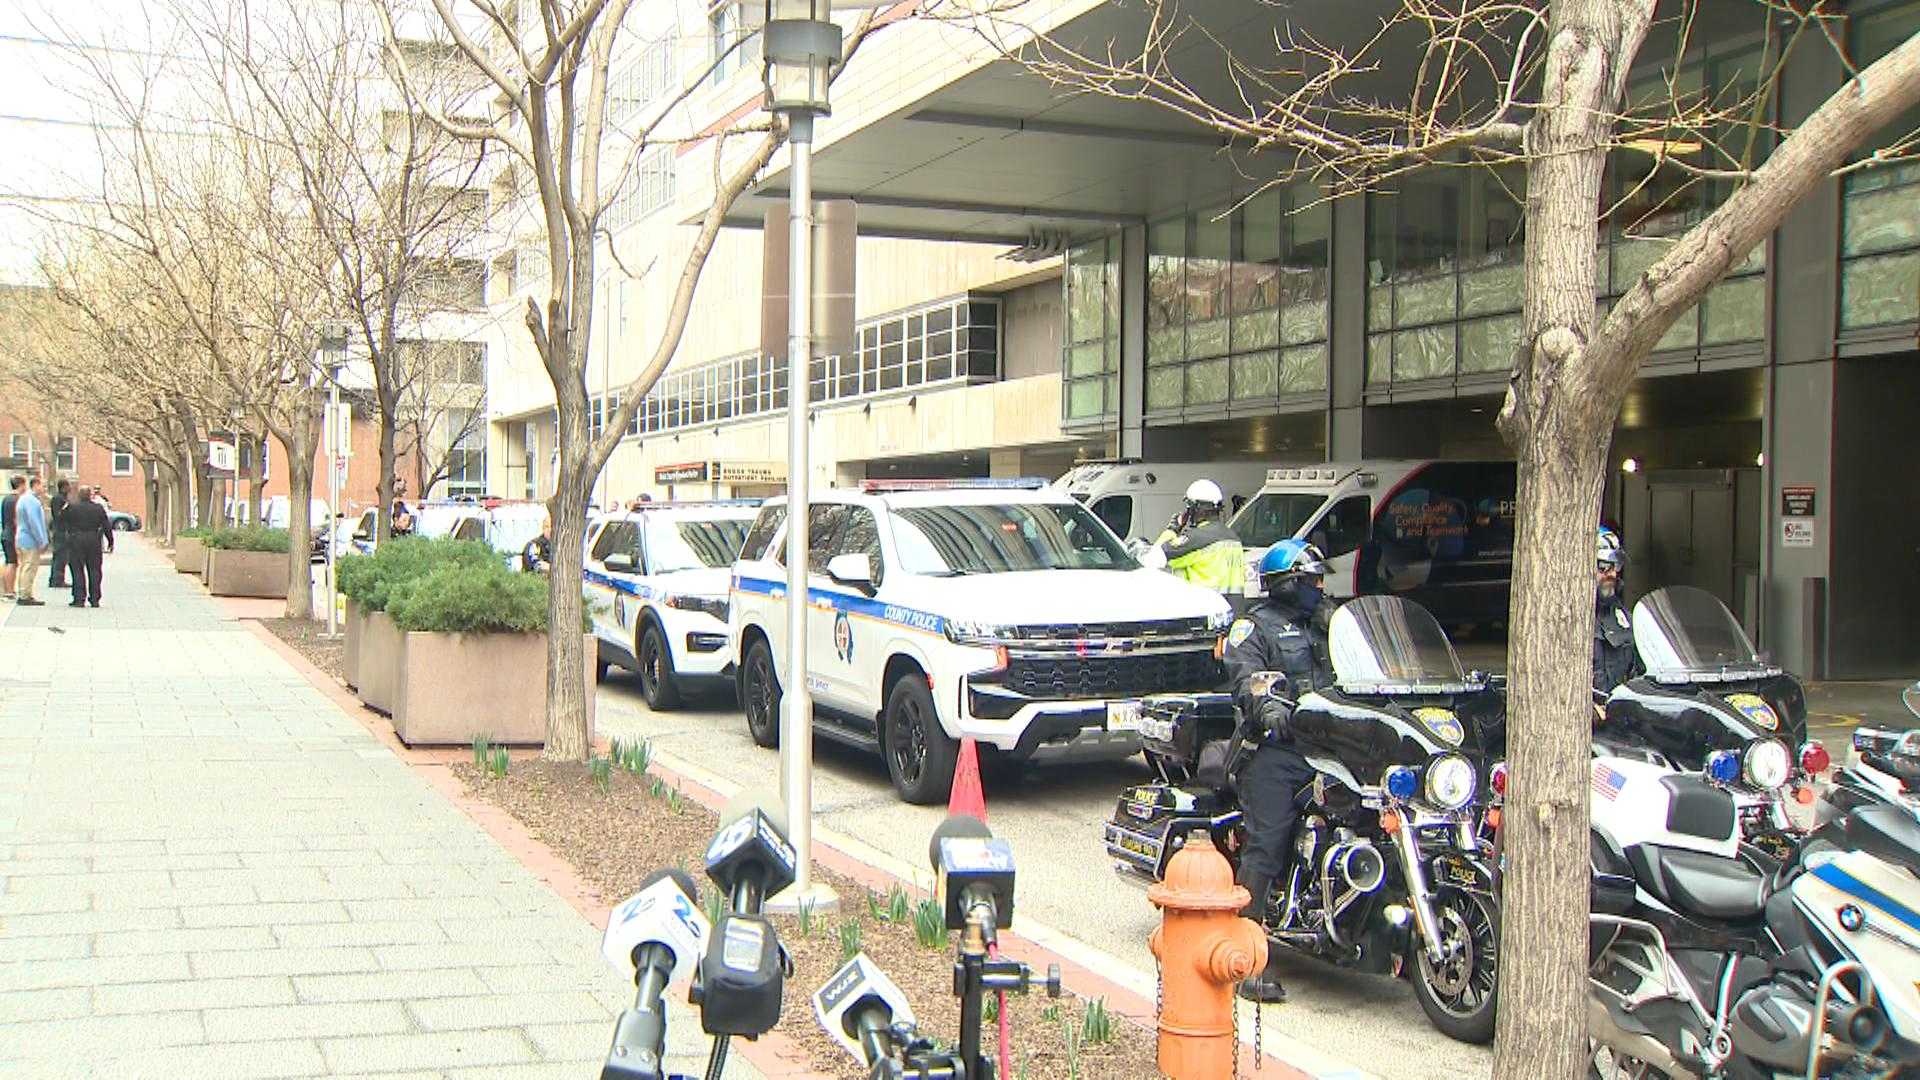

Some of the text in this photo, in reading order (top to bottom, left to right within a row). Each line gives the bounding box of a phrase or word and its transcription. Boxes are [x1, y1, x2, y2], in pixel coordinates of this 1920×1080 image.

[1407, 526, 1422, 536] and
[884, 604, 938, 630] COUNTY POLICE
[1134, 788, 1158, 805] POLICE
